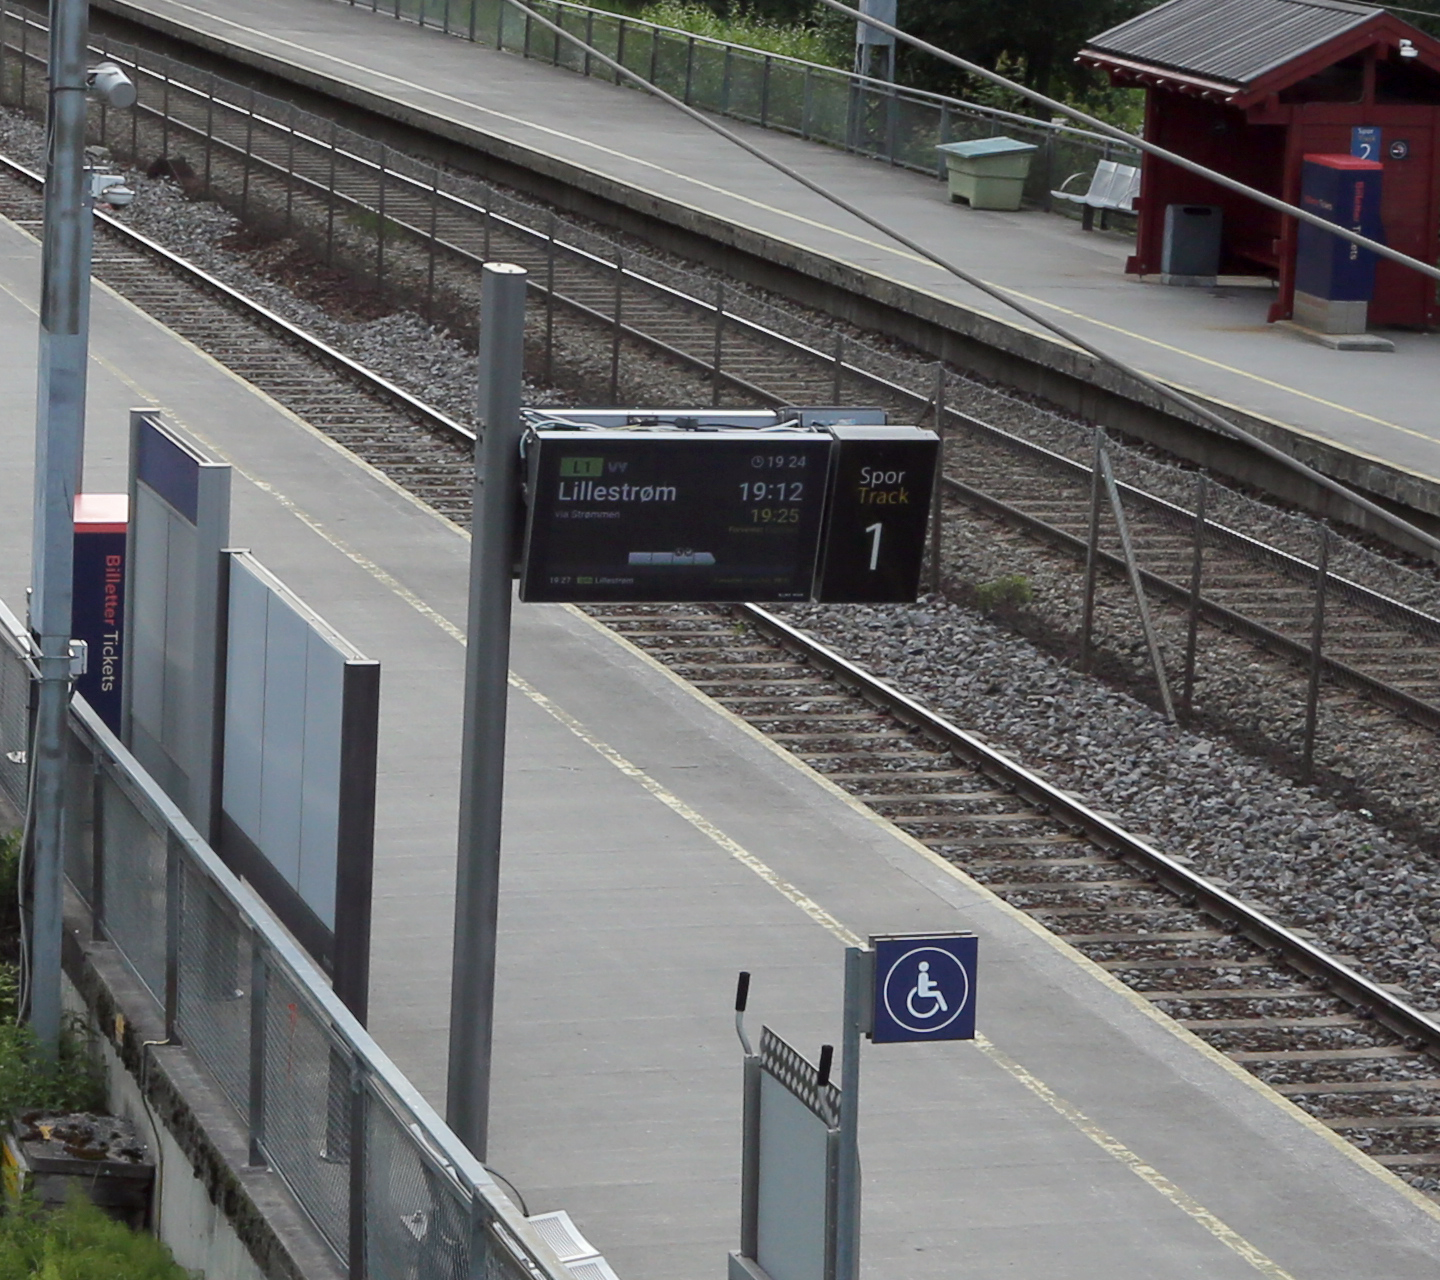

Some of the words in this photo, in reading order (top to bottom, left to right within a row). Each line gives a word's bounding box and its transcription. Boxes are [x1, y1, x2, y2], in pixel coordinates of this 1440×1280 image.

[1360, 143, 1371, 160] 2
[573, 461, 591, 474] L1
[860, 466, 906, 488] Spor
[558, 480, 676, 503] Lillestrøm
[739, 482, 804, 501] 19:12
[859, 487, 910, 505] Track
[571, 509, 621, 519] Strømmen
[751, 508, 800, 523] 19:25
[865, 522, 883, 571] 1
[104, 555, 121, 626] Billetter
[101, 630, 119, 692] Tickets
